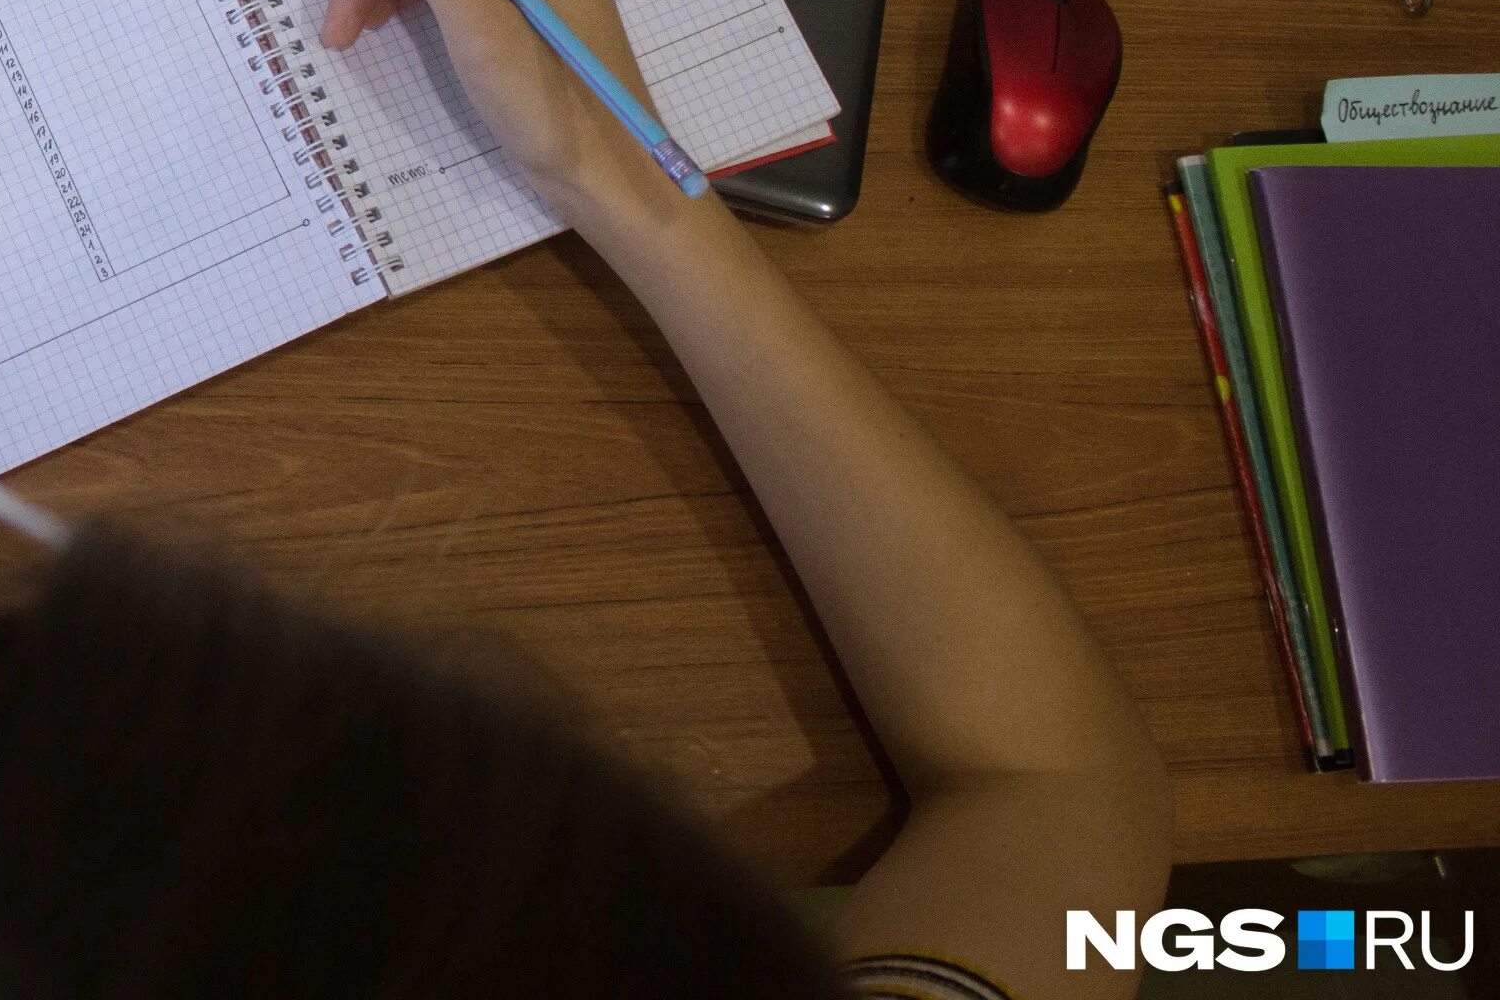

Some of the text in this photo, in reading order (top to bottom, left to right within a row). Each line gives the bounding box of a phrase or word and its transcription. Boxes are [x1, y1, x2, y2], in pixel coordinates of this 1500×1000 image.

[0, 44, 9, 56] 11
[5, 58, 17, 69] 12
[11, 70, 23, 83] 13
[16, 84, 28, 97] 14
[23, 98, 34, 110] 15
[1337, 88, 1500, 126] Обществознание
[28, 111, 40, 124] 16
[35, 125, 47, 139] 17
[42, 138, 53, 152] 18
[49, 153, 60, 166] 19
[54, 166, 67, 181] 20
[60, 180, 74, 194] 21
[67, 195, 83, 210] 22
[73, 210, 88, 223] 23
[79, 223, 93, 238] 24
[87, 239, 95, 251] 1
[94, 254, 104, 265] 2
[100, 267, 110, 279] 3
